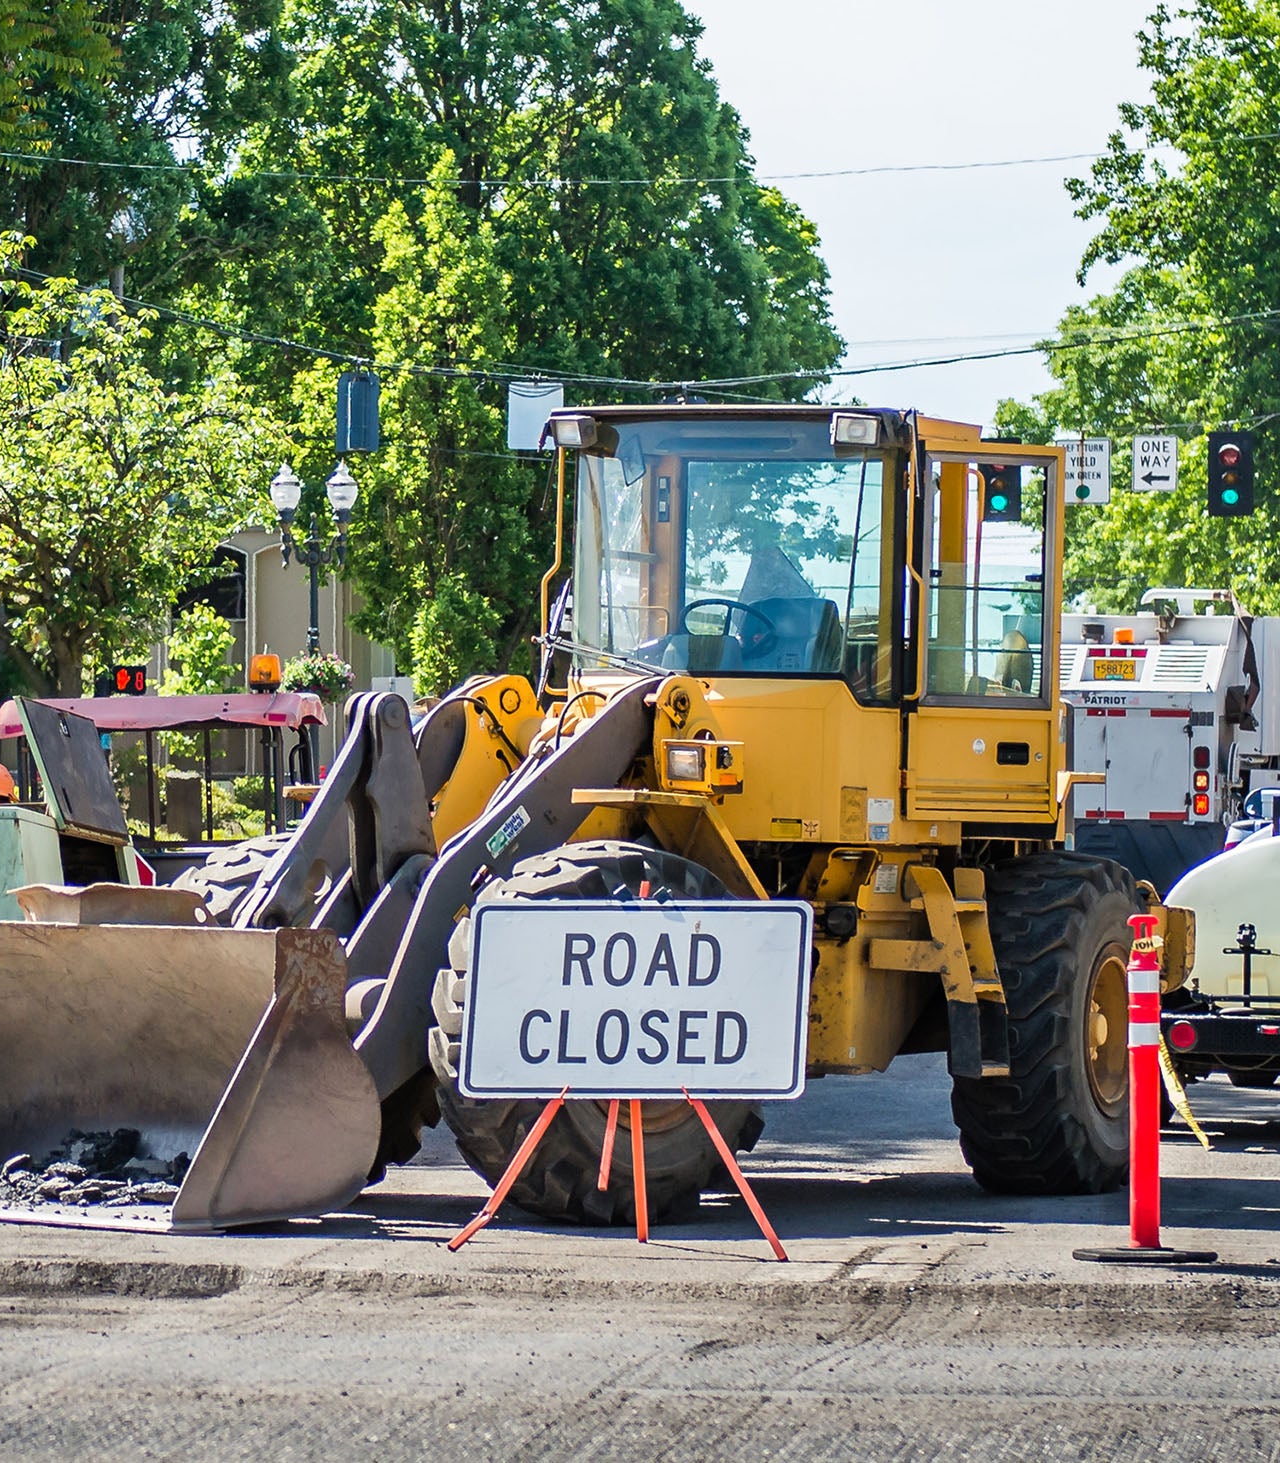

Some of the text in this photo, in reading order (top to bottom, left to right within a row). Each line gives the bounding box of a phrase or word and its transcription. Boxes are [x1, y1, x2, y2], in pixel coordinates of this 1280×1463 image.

[1084, 444, 1104, 453] TURN
[1141, 440, 1170, 453] ONE
[1140, 455, 1171, 468] WAY
[135, 671, 144, 691] 8
[1084, 696, 1127, 705] PATRIOT
[561, 931, 722, 987] ROAD
[519, 1008, 748, 1065] CLOSED
